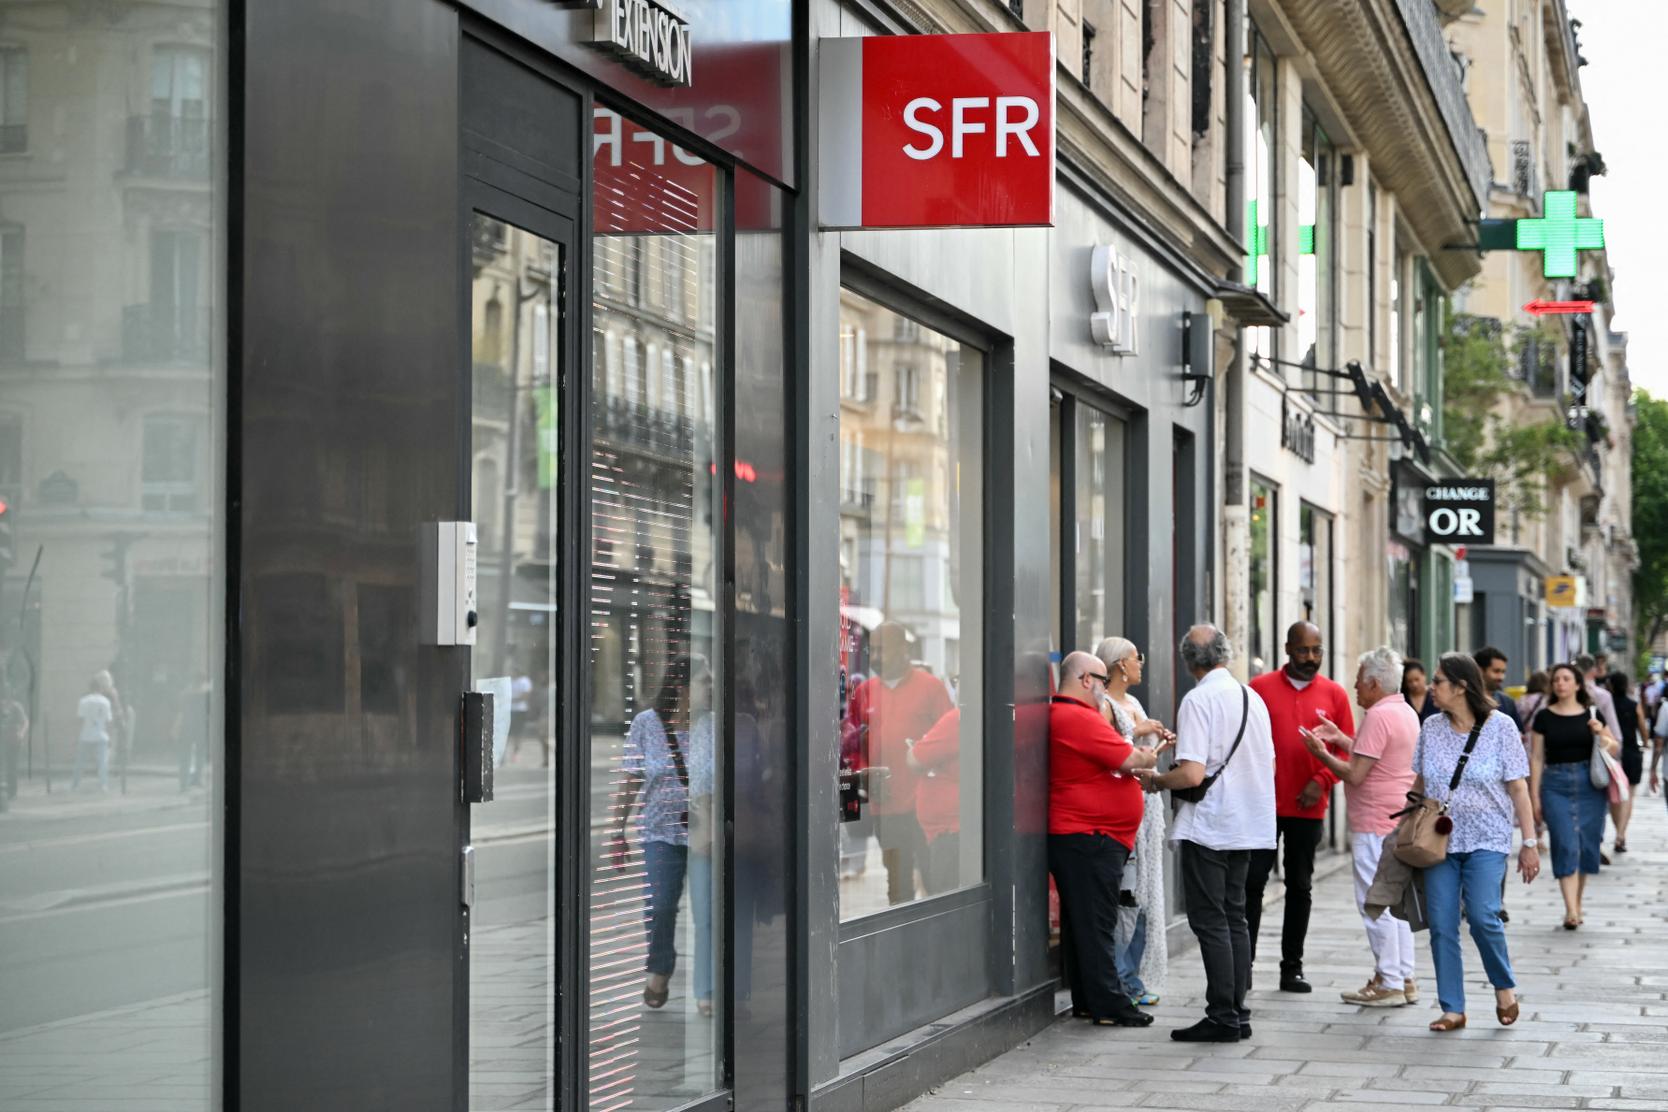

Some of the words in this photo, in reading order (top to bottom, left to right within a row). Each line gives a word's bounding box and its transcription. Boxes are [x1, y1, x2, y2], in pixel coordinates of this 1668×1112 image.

[902, 96, 1041, 161] SFR
[1091, 244, 1138, 357] SFR
[1425, 486, 1490, 501] CHANGE
[1429, 507, 1485, 536] OR
